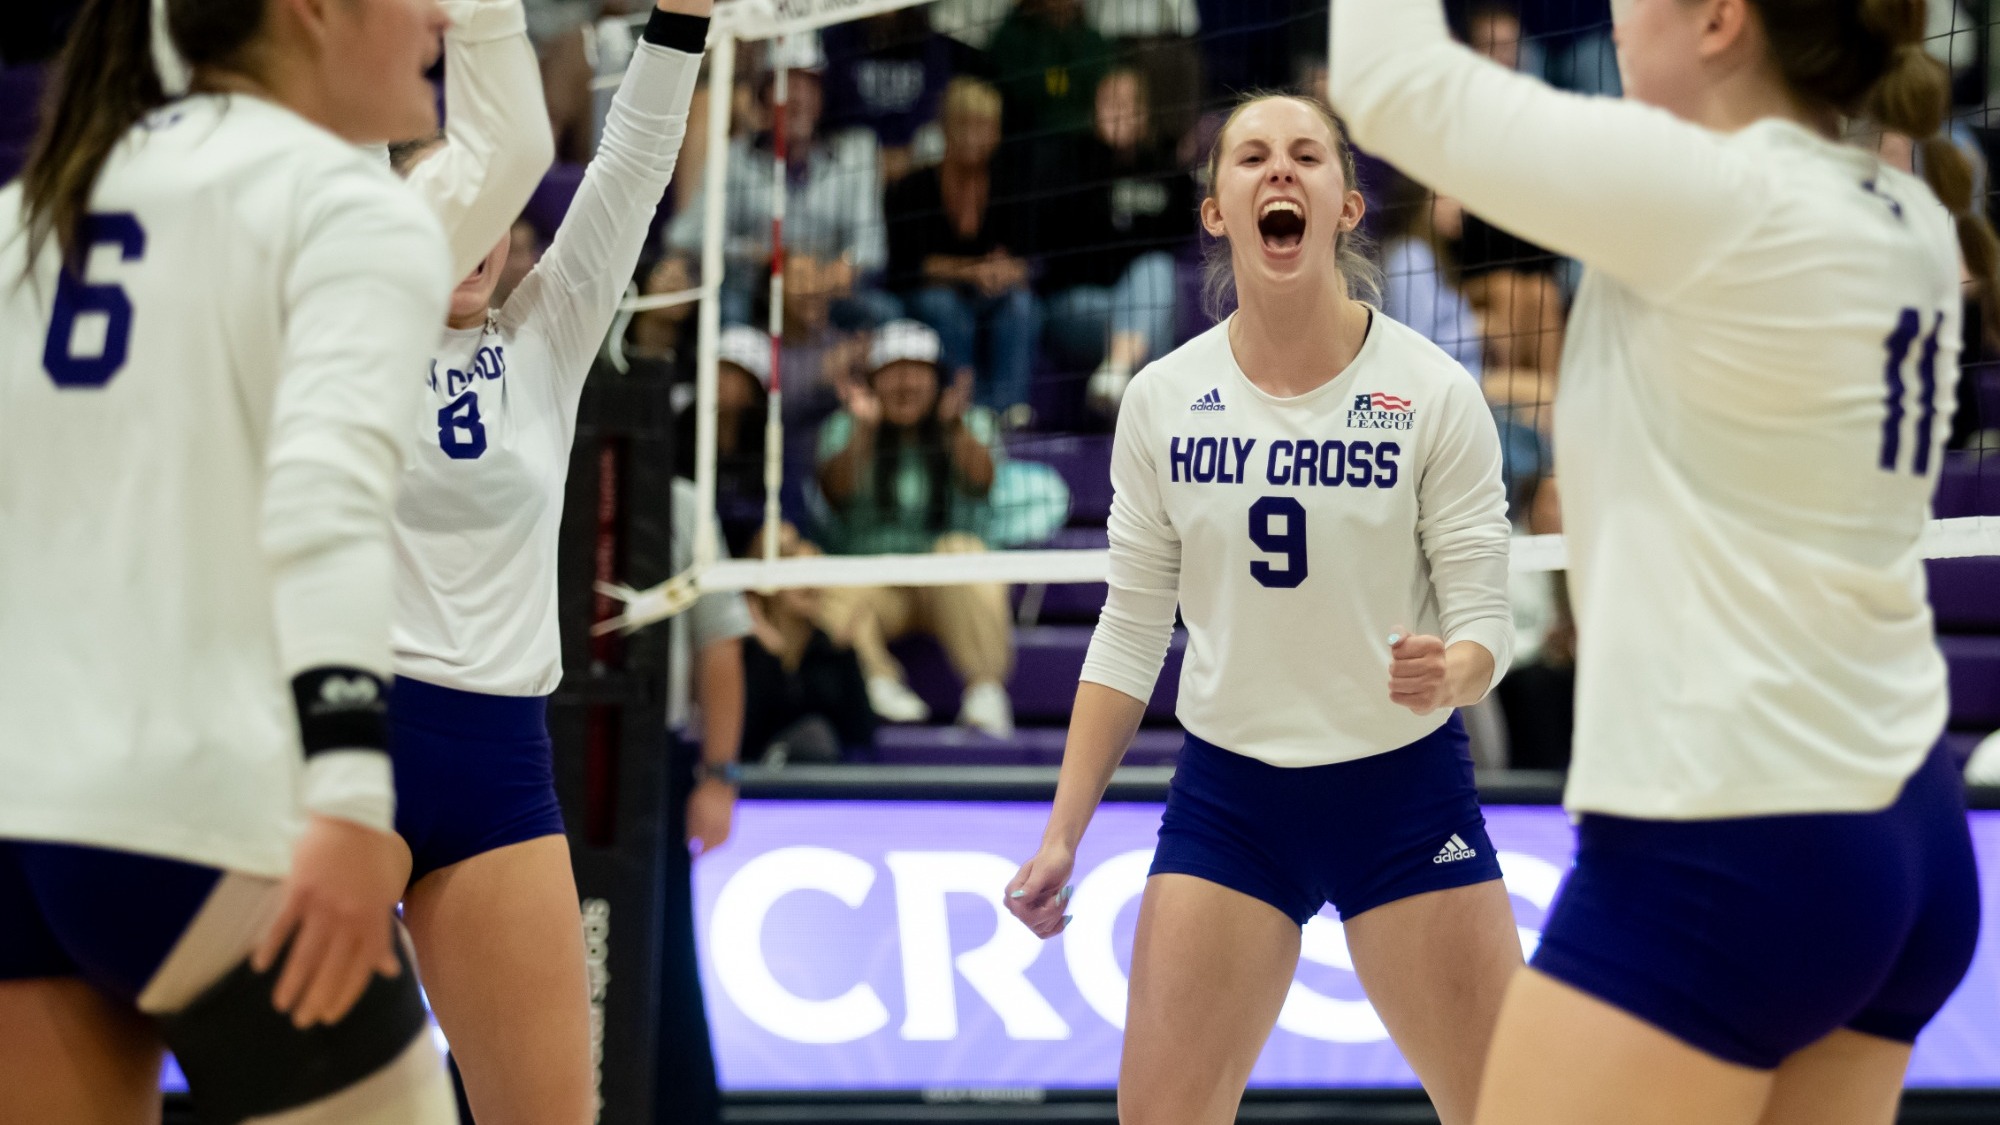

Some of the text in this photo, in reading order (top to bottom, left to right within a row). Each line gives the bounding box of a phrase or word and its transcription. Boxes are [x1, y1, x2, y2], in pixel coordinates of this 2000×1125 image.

[43, 212, 147, 389] 6
[1190, 401, 1226, 411] adidas
[1347, 410, 1416, 422] PATRIOT
[1878, 307, 1945, 477] 11
[438, 391, 487, 460] 8
[1347, 419, 1414, 431] LEAGUE
[1170, 436, 1401, 489] HOLY CROSS
[1248, 495, 1308, 589] 9
[1433, 848, 1476, 863] adidas
